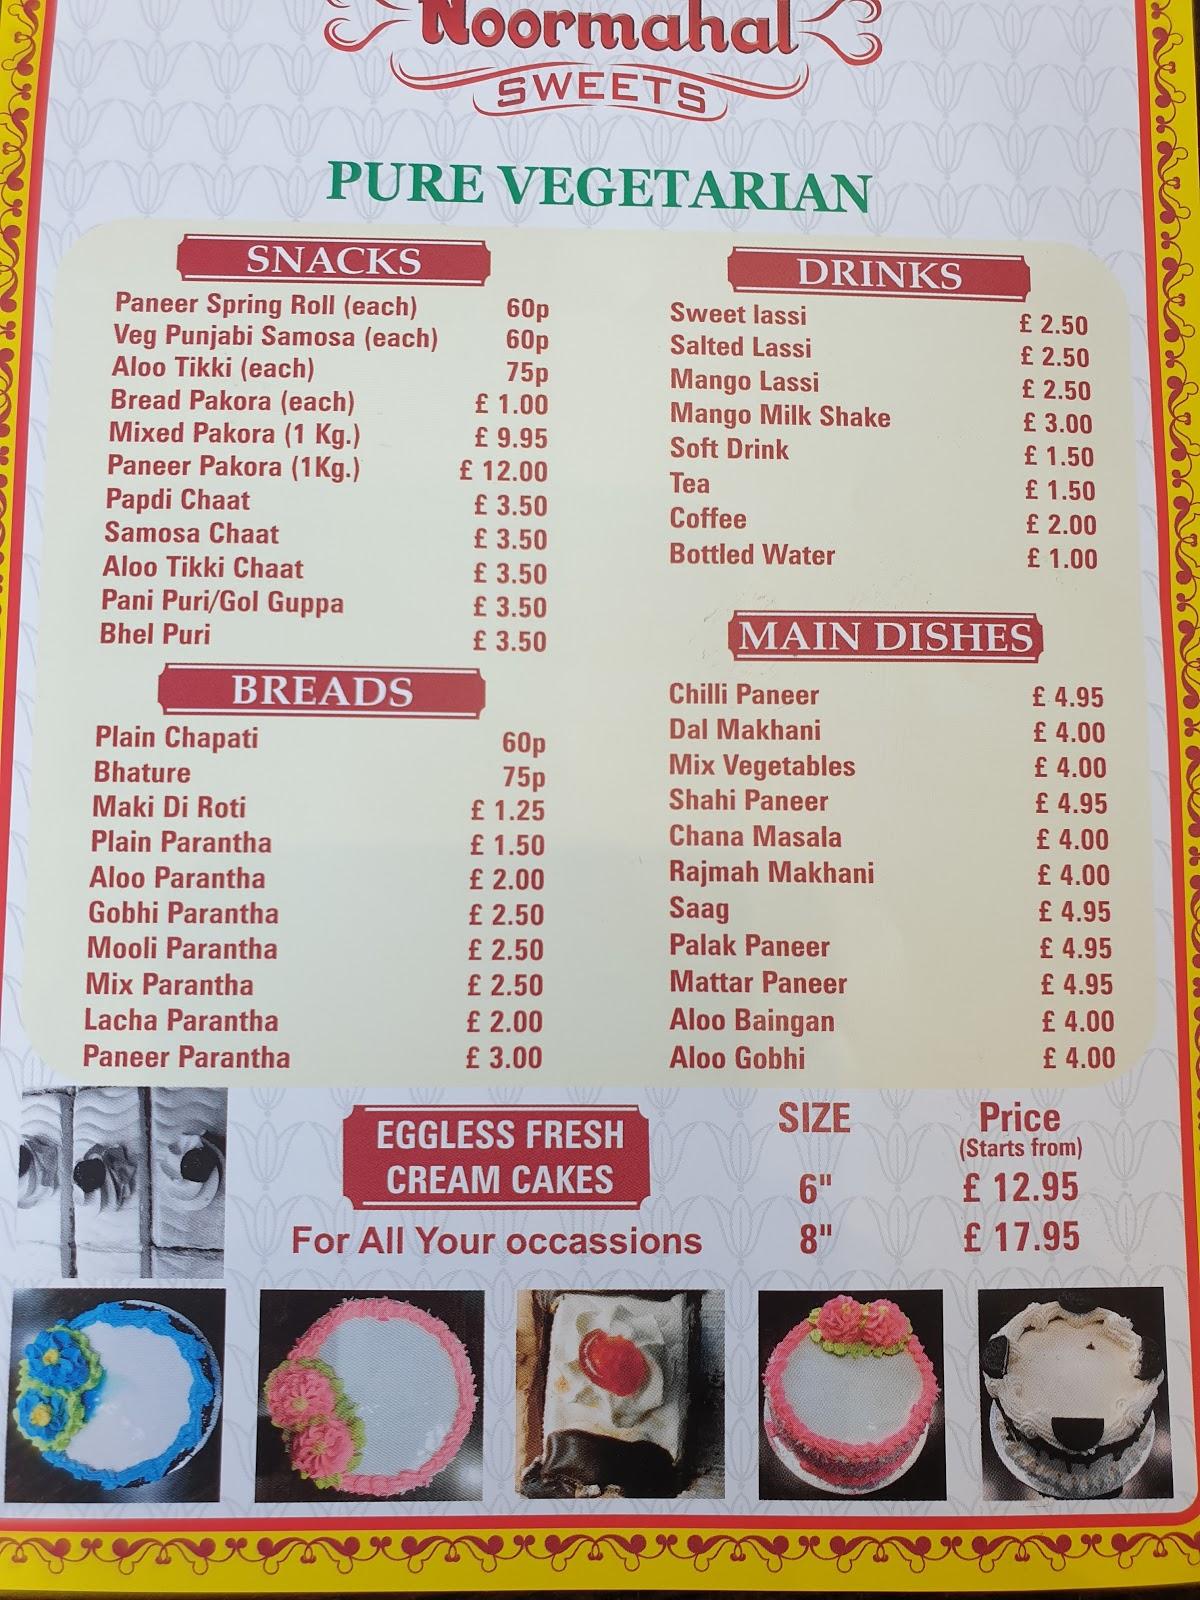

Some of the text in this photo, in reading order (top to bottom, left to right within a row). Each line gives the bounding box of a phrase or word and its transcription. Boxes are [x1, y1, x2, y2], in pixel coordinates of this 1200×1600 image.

[418, 0, 799, 55] Noormahal
[498, 72, 706, 114] SWEETS
[328, 160, 870, 214] PURE VEGETARIAN
[246, 244, 422, 276] SNACKS
[796, 257, 963, 291] DRINKS
[115, 290, 417, 321] Paneer Spring Roll (each)
[506, 297, 550, 324] 60p
[670, 302, 807, 326] Sweet lassi
[113, 322, 438, 353] Veg Punjabi Samosa (each)
[1040, 313, 1089, 336] 2.50
[506, 328, 549, 355] 60p
[670, 333, 812, 359] Salted Lassi
[111, 355, 315, 384] Aloo Tikki (each)
[506, 361, 549, 388] 75p
[670, 367, 819, 396] Mango Lassi
[110, 388, 355, 417] Bread Pakora (each)
[498, 393, 549, 416] 1.00
[670, 401, 891, 430] Mango Milk Shake
[108, 420, 361, 451] Mixed Pakora (1 Kg.)
[1044, 412, 1093, 435] 3.00
[497, 426, 548, 449] 9.95
[670, 435, 789, 461] Soft Drink
[107, 453, 192, 477] Paneer
[199, 454, 282, 477] Pakora
[483, 459, 548, 483] 12.00
[669, 471, 710, 494] Tea
[1047, 479, 1096, 502] 1.50
[105, 487, 251, 515] Papdi Chaat
[496, 494, 548, 517] 3.50
[670, 506, 747, 530] Coffee
[104, 520, 280, 545] Samosa Chaat
[669, 541, 836, 566] Bottled Water
[1049, 547, 1098, 570] 1.00
[102, 554, 305, 580] Aloo Tikki Chaat
[101, 588, 344, 619] Pani Puri/Gol Guppa
[99, 621, 211, 646] Bhel Puri
[495, 629, 547, 653] 3.50
[738, 621, 1033, 653] MAIN DISHES
[232, 674, 414, 708] BREADS
[669, 682, 820, 706] Chilli Paneer
[1054, 686, 1105, 709] 4.95
[95, 724, 258, 754] Plain Chapati
[669, 717, 821, 741] Dal Makhani
[502, 731, 546, 759] 60p
[93, 759, 191, 784] Bhature
[503, 765, 546, 793] 75p
[669, 753, 856, 782] Mix Vegetables
[92, 794, 246, 819] Maki Di Roti
[495, 799, 545, 822] 1.25
[669, 787, 829, 812] Shahi Paneer
[91, 829, 272, 854] Plain Parantha
[669, 823, 842, 848] Chana Masala
[1058, 828, 1109, 851] 4.00
[88, 864, 266, 889] Aloo Parantha
[669, 859, 875, 888] Rajmah Makhani
[88, 899, 279, 925] Gobhi Parantha
[669, 895, 730, 925] Saag
[87, 935, 278, 960] Mooli Parantha
[669, 932, 831, 958] Palak Paneer
[85, 971, 254, 997] Mix Parantha
[490, 973, 544, 997] 2.50
[670, 969, 848, 995] Mattar Paneer
[84, 1007, 279, 1032] Lacha Parantha
[669, 1007, 835, 1038] Aloo Baingan
[83, 1043, 291, 1069] Paneer Parantha
[489, 1045, 543, 1070] 3.00
[669, 1044, 805, 1070] Aloo Gobhi
[1065, 1046, 1116, 1070] 4.00
[778, 1101, 851, 1134] SIZE
[979, 1100, 1061, 1133] Price
[377, 1119, 624, 1150] EGGLESS FRESH
[959, 1136, 1083, 1162] (Starts from)
[387, 1164, 614, 1195] CREAM CAKES
[994, 1170, 1079, 1203] 12.95
[292, 1225, 703, 1255] For All Your occassions
[994, 1220, 1080, 1252] 17.95
